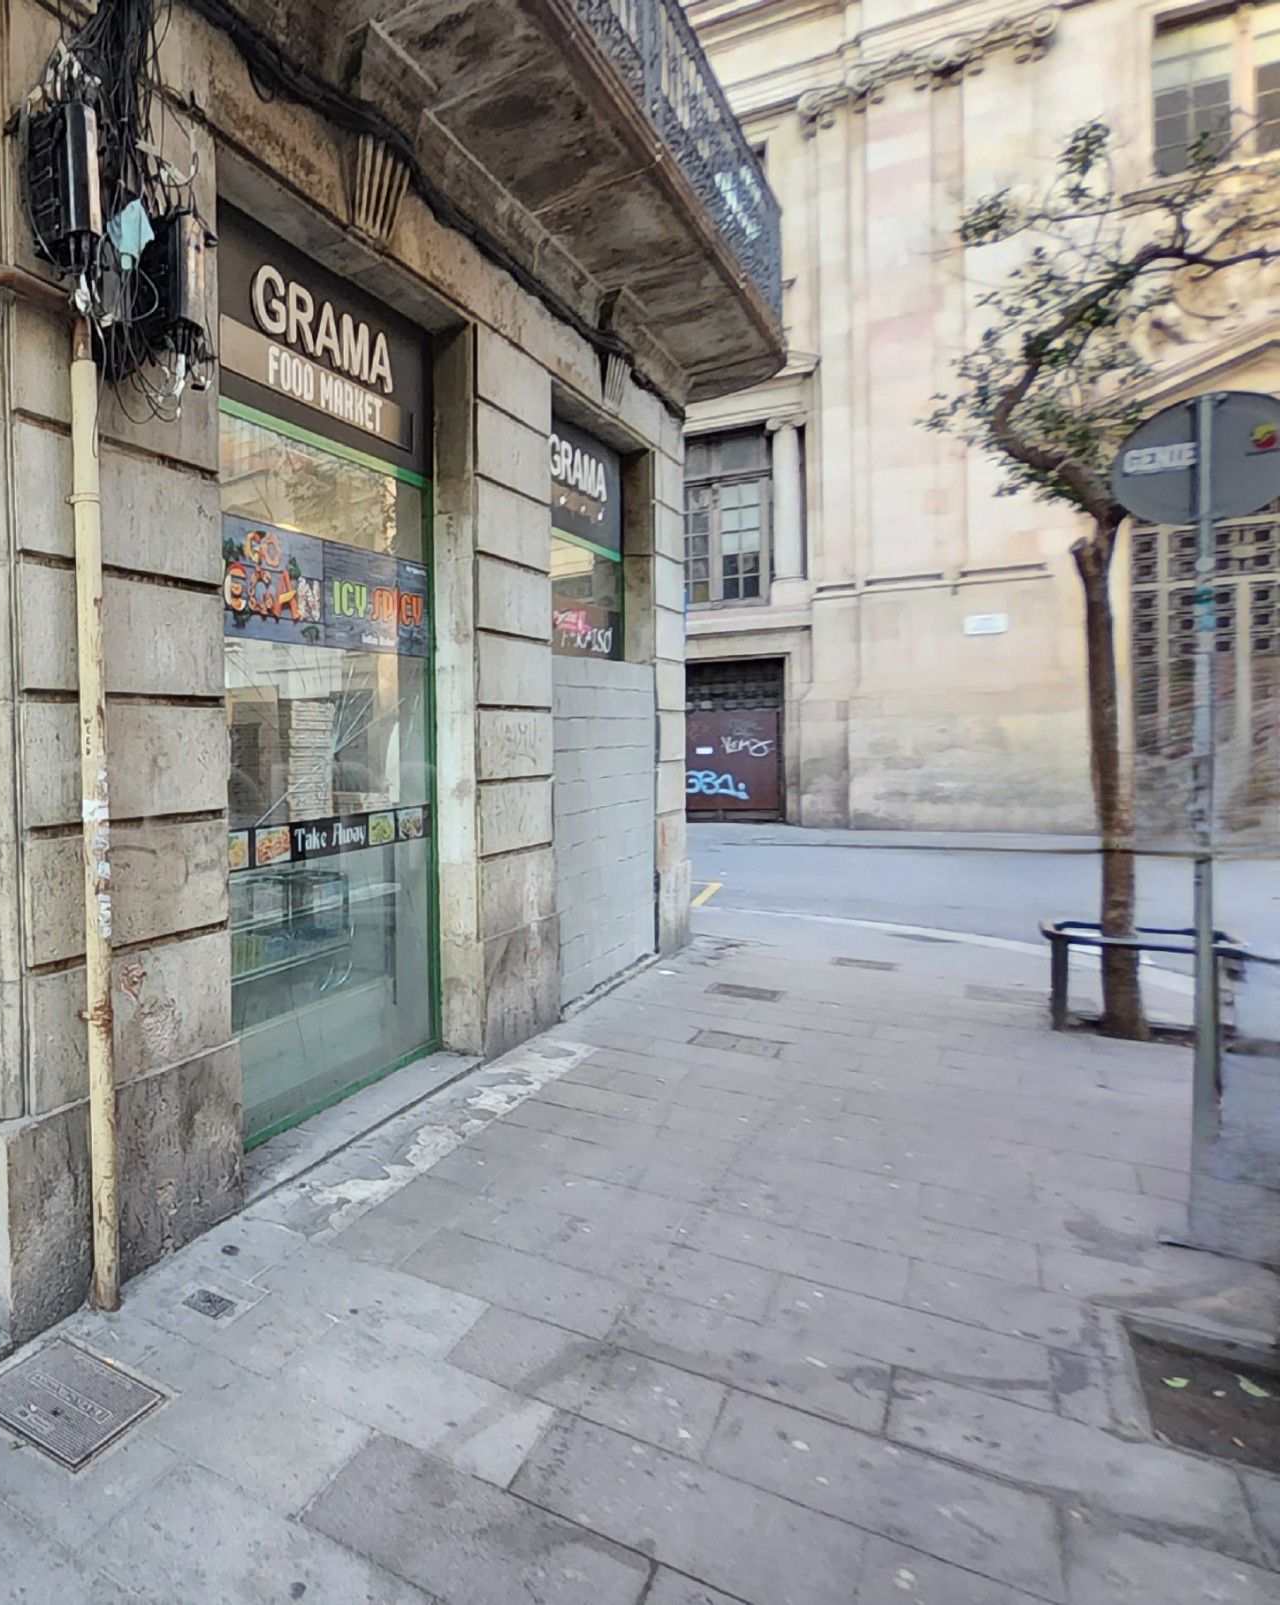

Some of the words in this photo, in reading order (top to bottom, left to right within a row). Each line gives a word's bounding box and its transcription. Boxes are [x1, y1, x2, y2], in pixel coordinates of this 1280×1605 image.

[252, 265, 393, 394] GRAMA
[268, 345, 314, 401] FOOD
[320, 371, 384, 433] MARKET
[548, 433, 608, 503] GRAMA
[244, 530, 283, 568] GO
[222, 561, 321, 622] EGAN
[332, 579, 368, 619] ICY
[371, 586, 424, 628] SPICY
[293, 829, 327, 853] Take
[331, 822, 367, 848] Away
